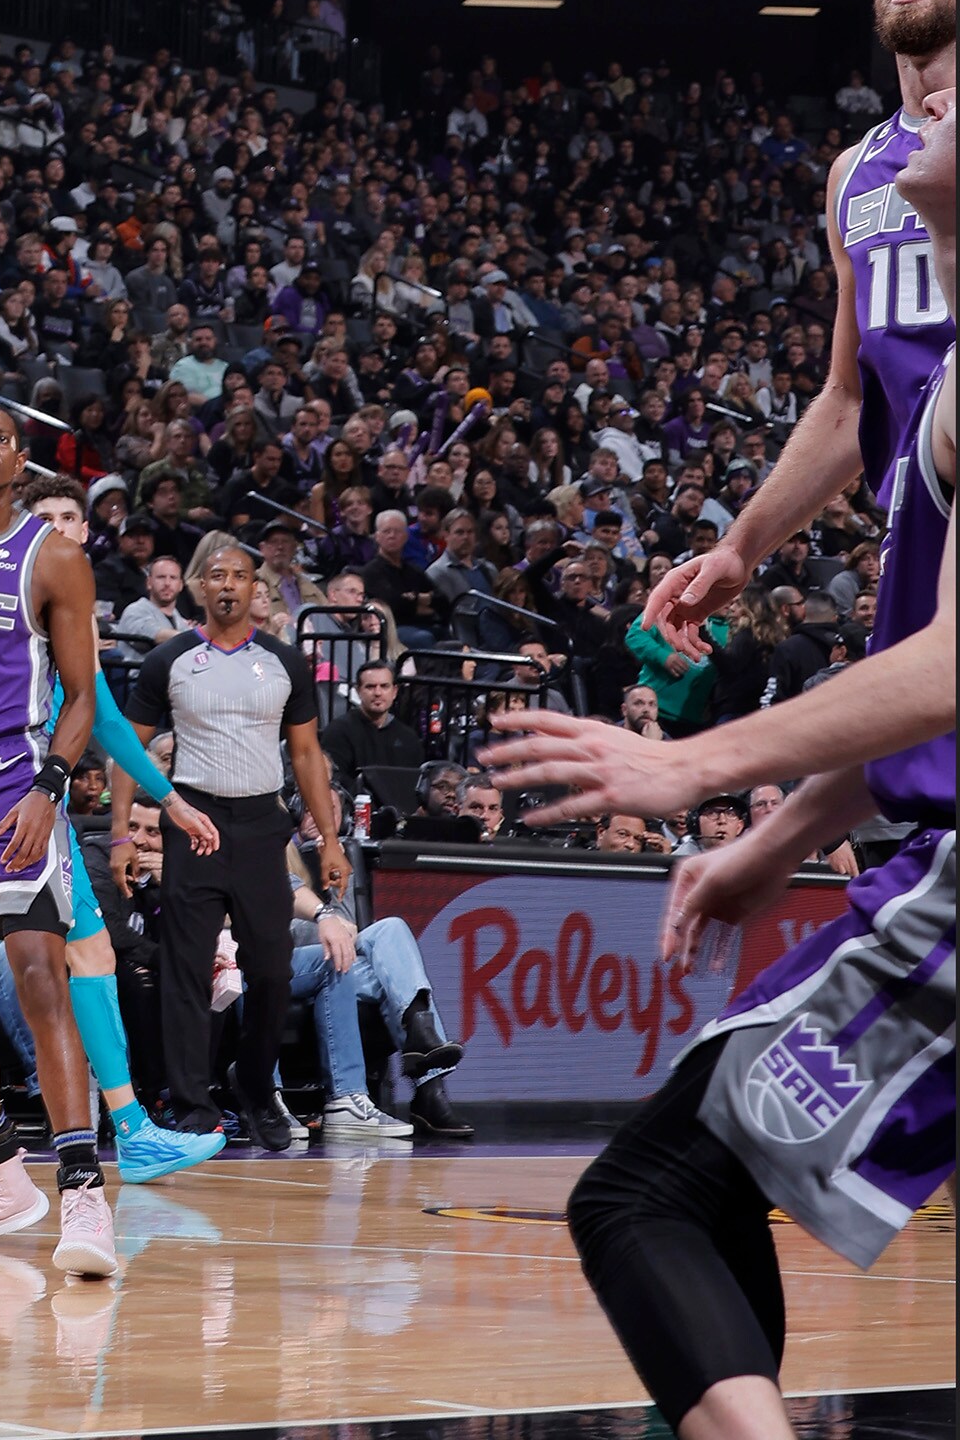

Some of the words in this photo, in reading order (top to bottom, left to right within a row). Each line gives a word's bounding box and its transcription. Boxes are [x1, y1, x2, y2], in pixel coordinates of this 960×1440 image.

[876, 122, 894, 141] 6
[843, 181, 926, 249] SA
[867, 238, 952, 331] 10
[447, 906, 696, 1078] Raleys
[761, 1043, 840, 1129] SAC
